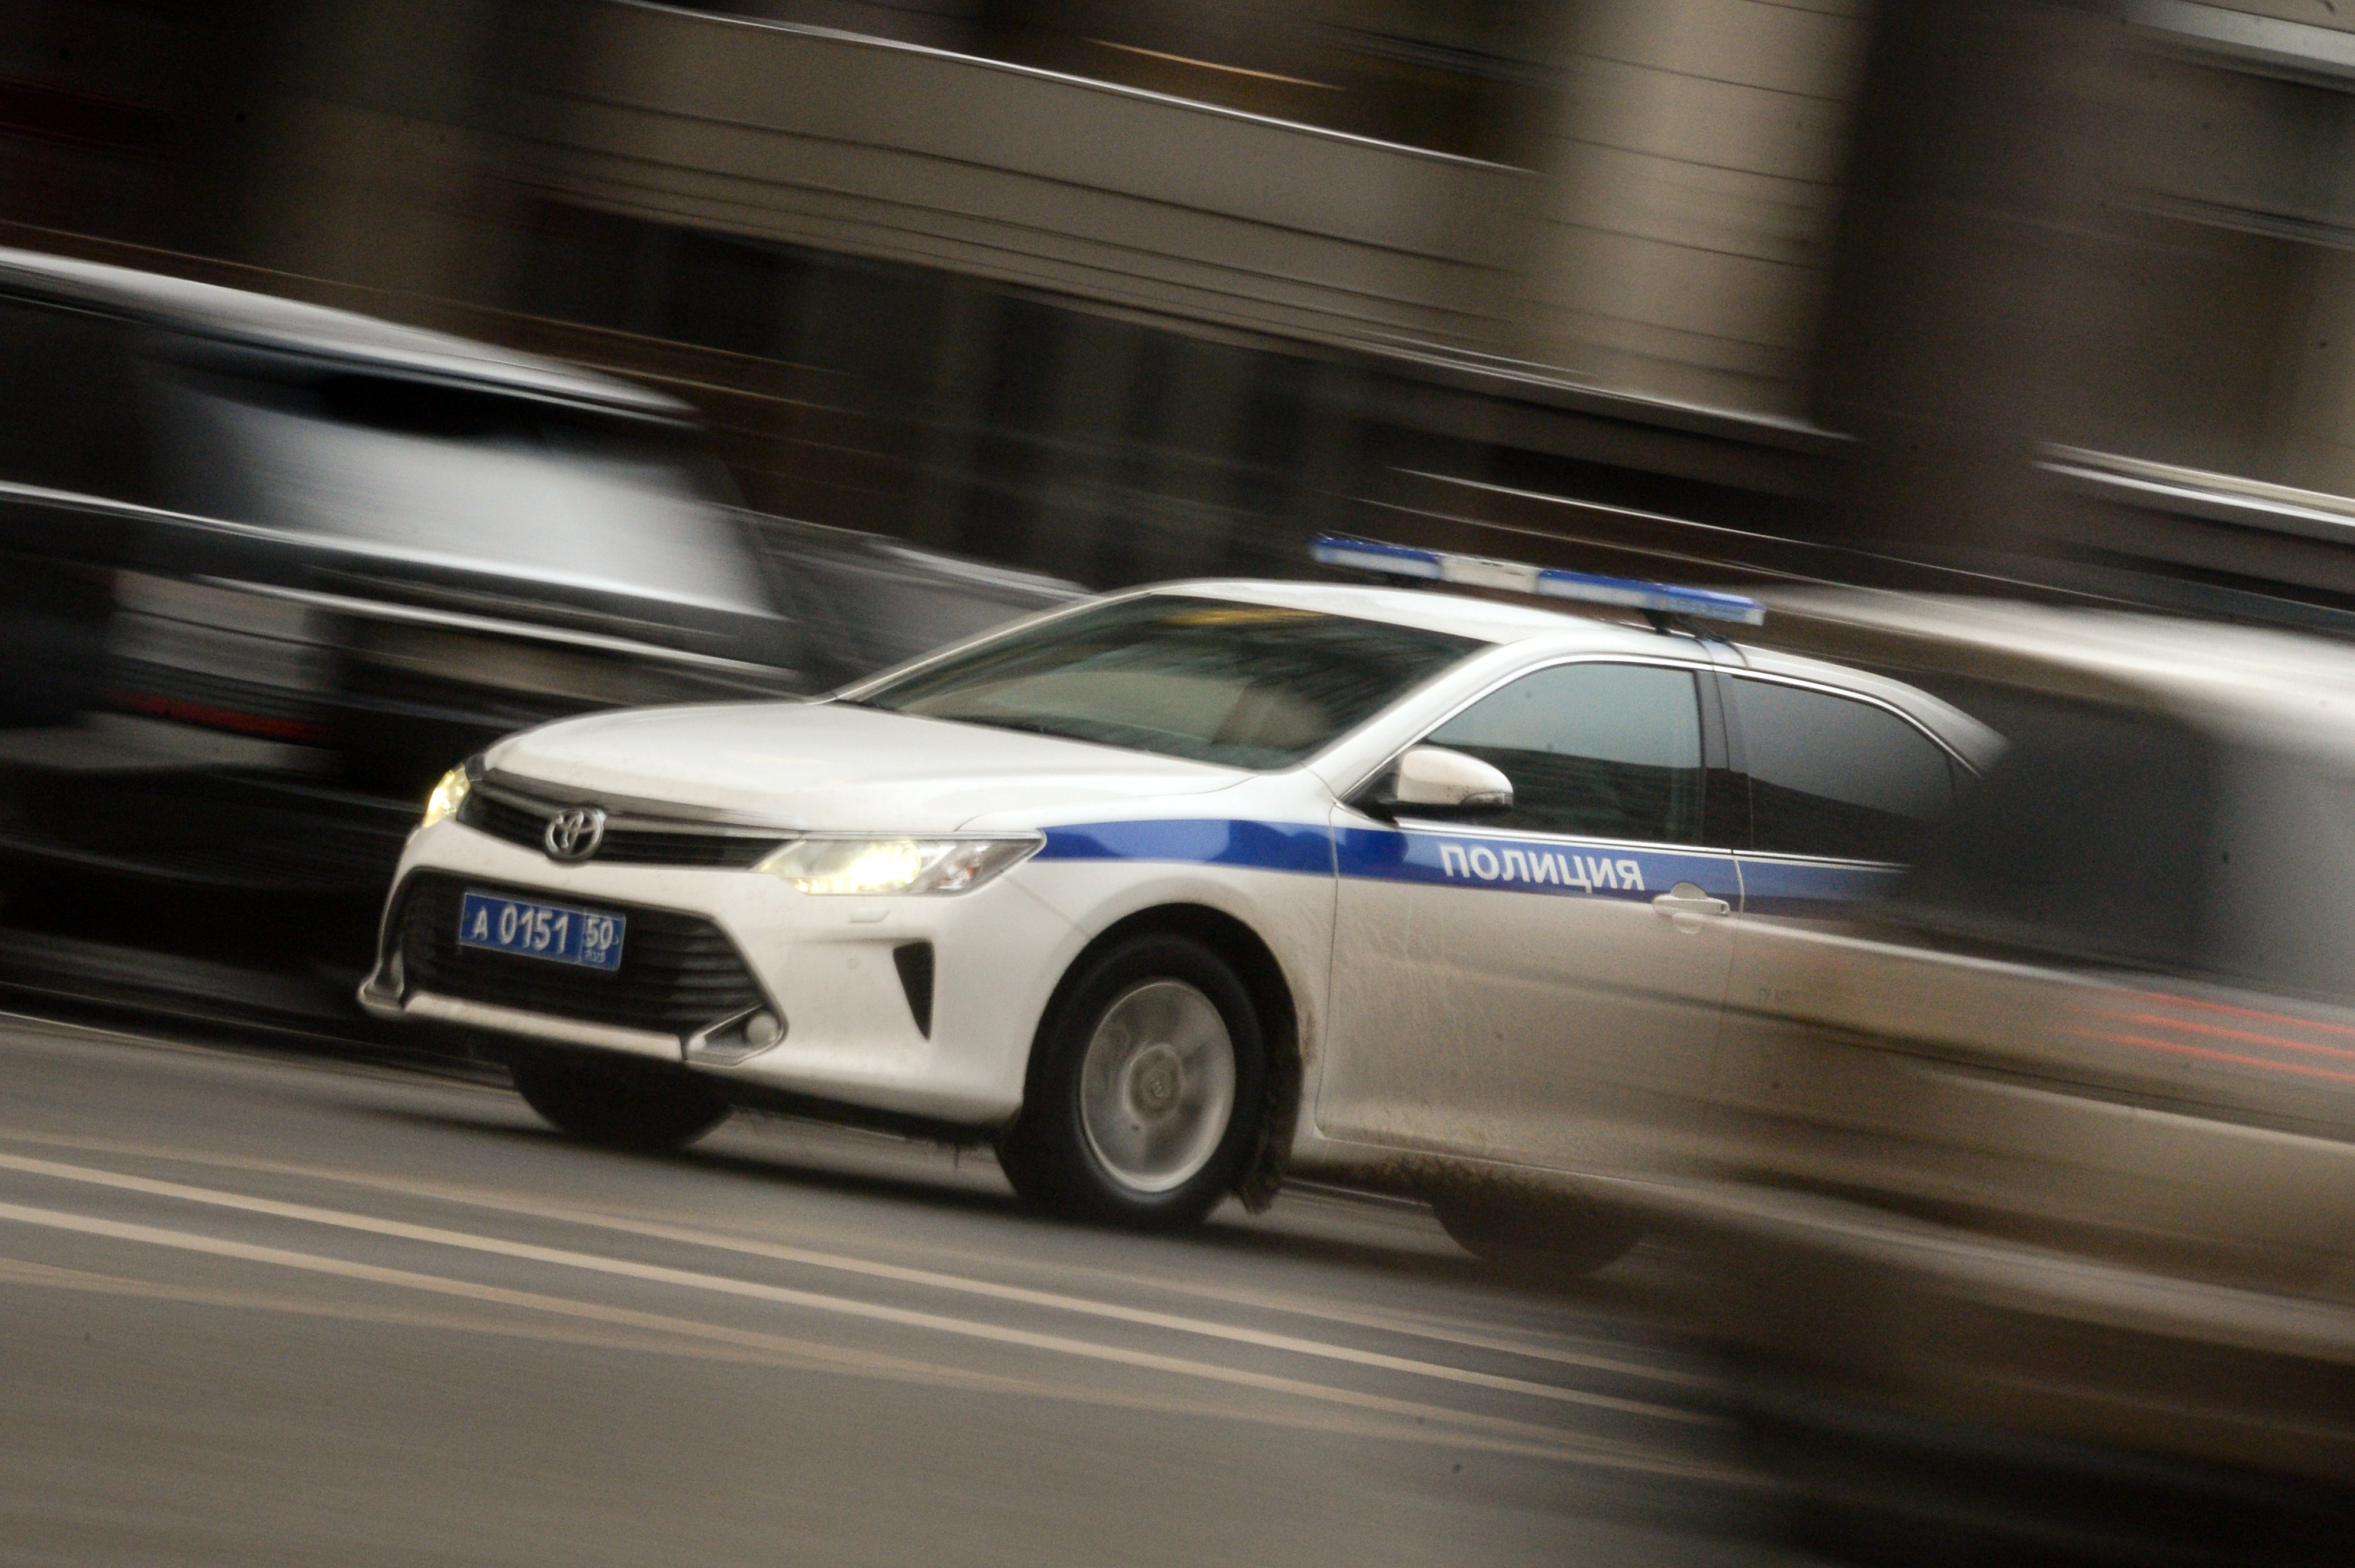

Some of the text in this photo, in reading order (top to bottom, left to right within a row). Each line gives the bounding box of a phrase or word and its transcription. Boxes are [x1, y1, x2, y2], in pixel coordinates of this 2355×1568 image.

[1439, 844, 1645, 893] ПОЛИЦИЯ
[500, 903, 569, 954] 0151
[583, 918, 614, 951] 50
